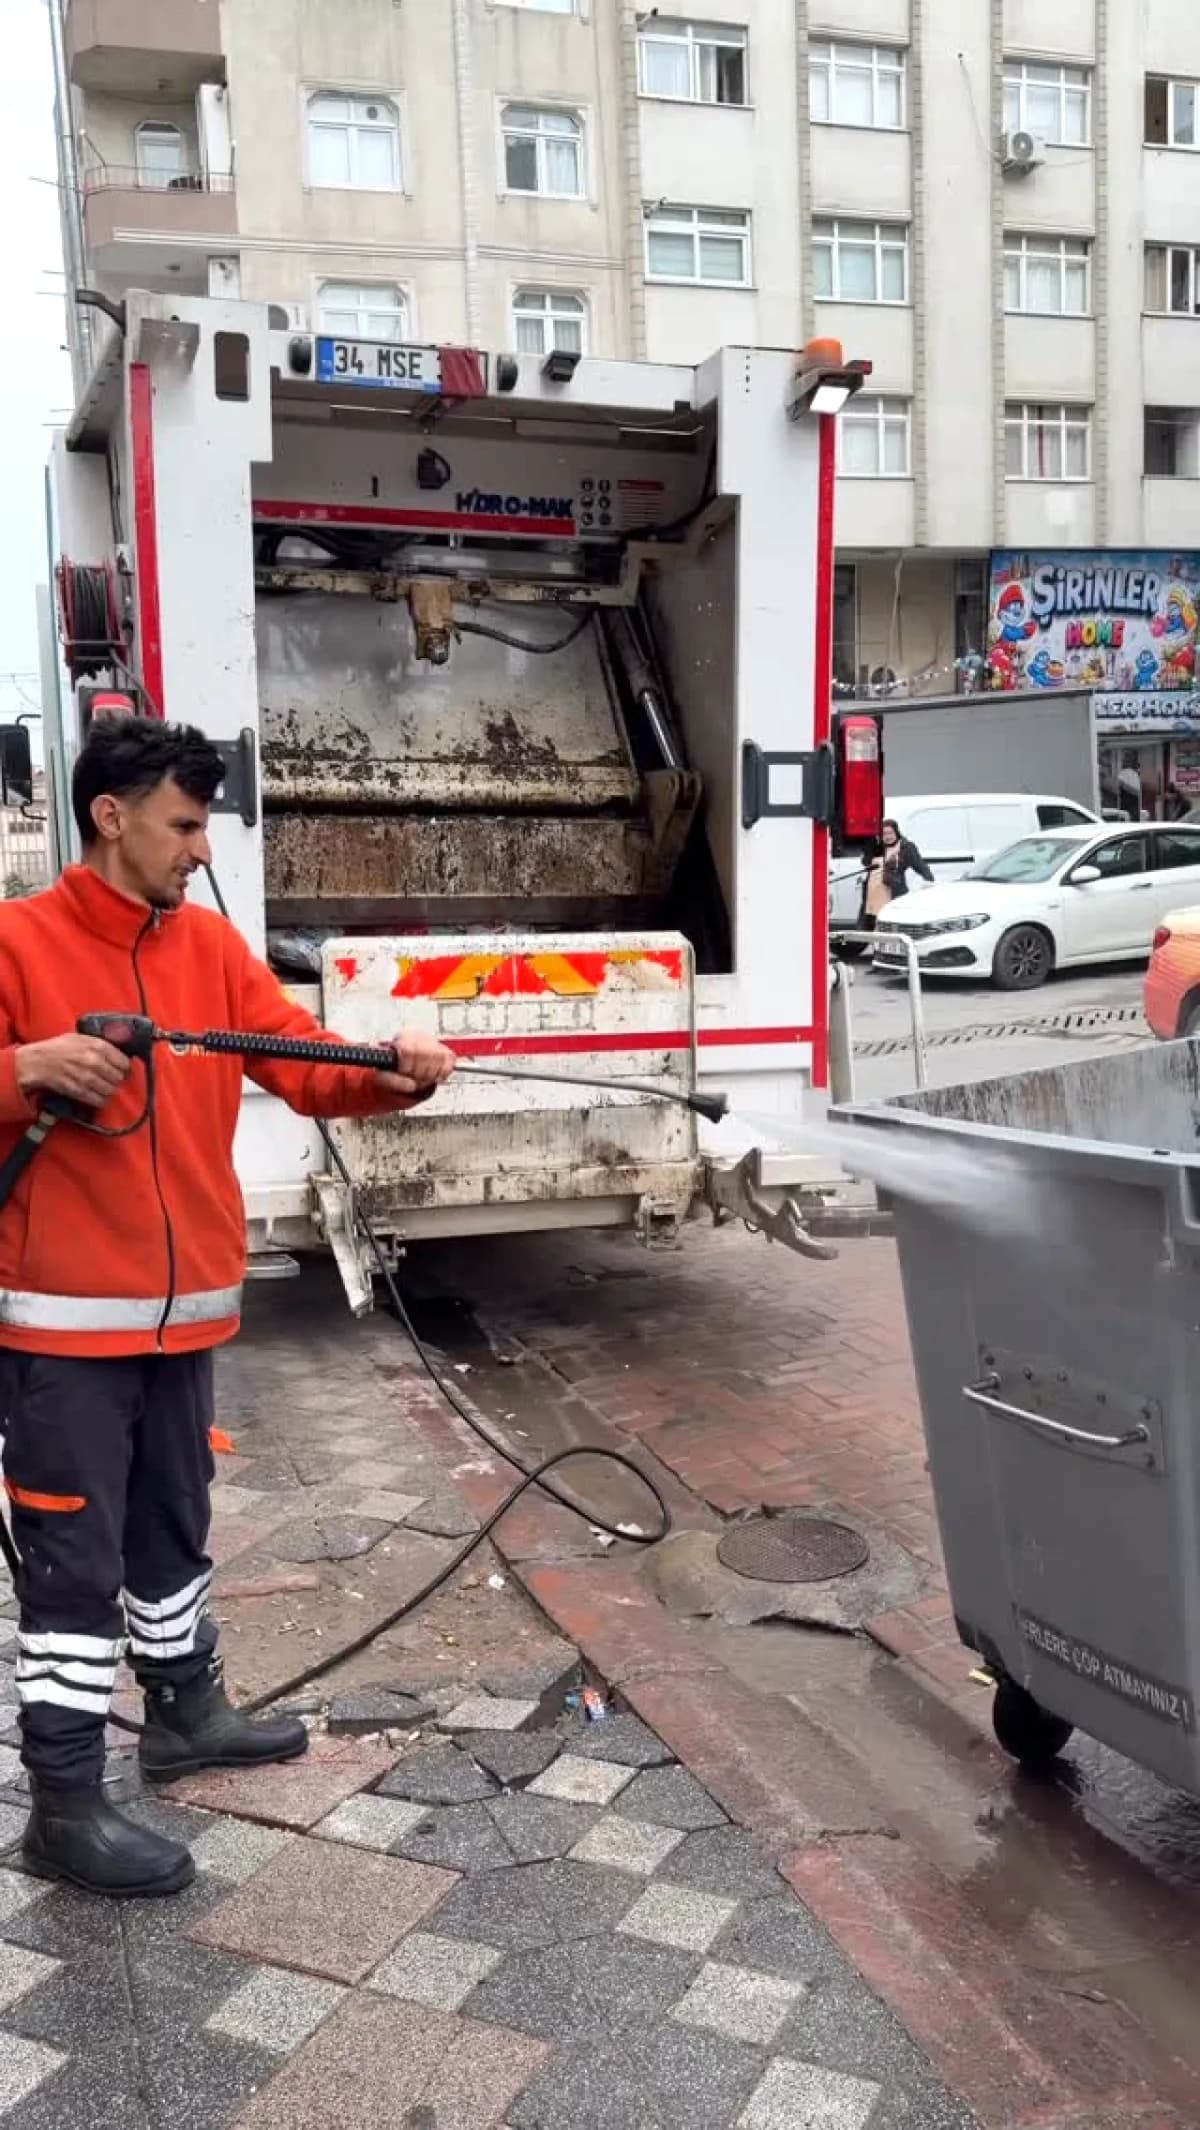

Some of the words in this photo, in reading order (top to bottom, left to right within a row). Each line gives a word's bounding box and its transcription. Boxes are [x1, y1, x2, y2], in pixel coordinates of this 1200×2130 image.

[335, 345, 363, 375] 34
[378, 349, 423, 379] MSE
[1065, 619, 1125, 648] HOME
